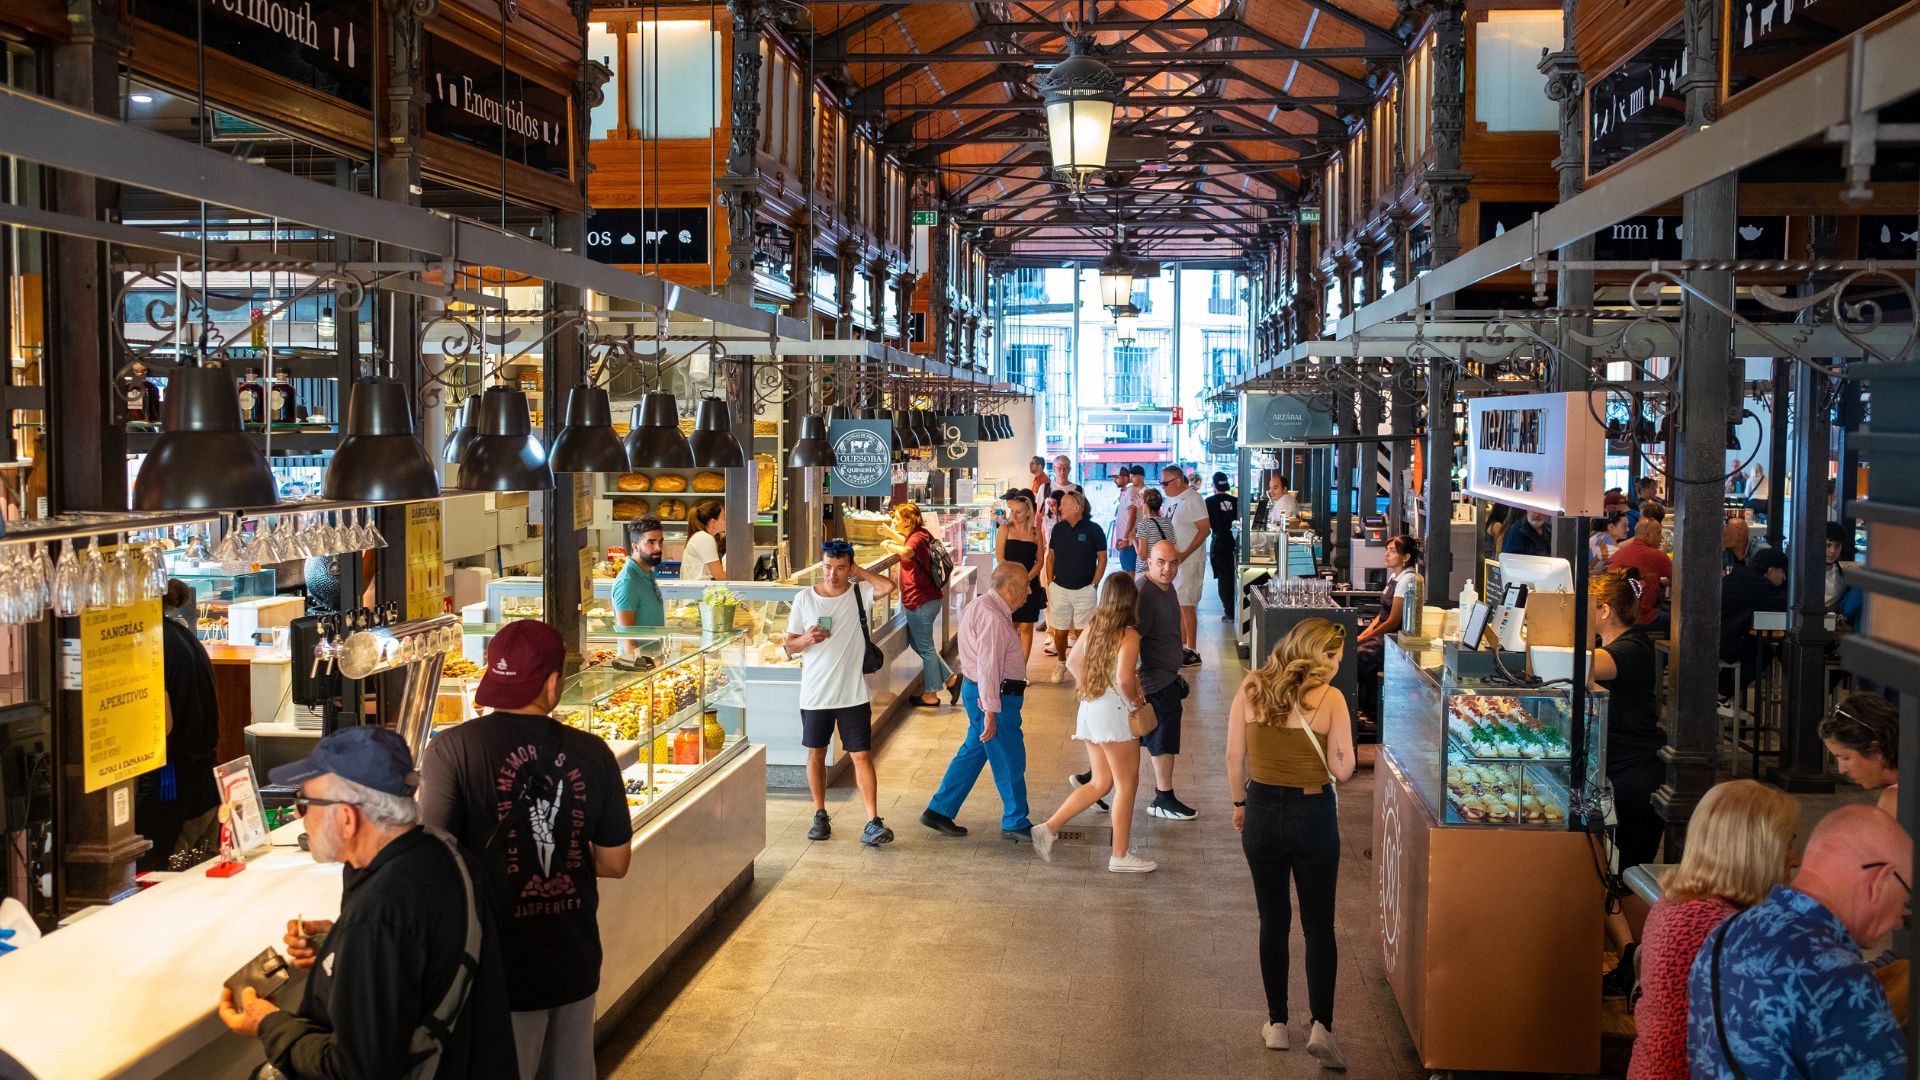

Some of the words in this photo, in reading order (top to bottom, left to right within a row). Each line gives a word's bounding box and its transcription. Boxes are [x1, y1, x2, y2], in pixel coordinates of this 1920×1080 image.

[212, 0, 320, 50] rmouth
[840, 455, 882, 463] QUESOBA
[100, 621, 144, 641] SANGRÍAS
[99, 688, 149, 711] APERITIVOS
[496, 744, 567, 792] MEMORS
